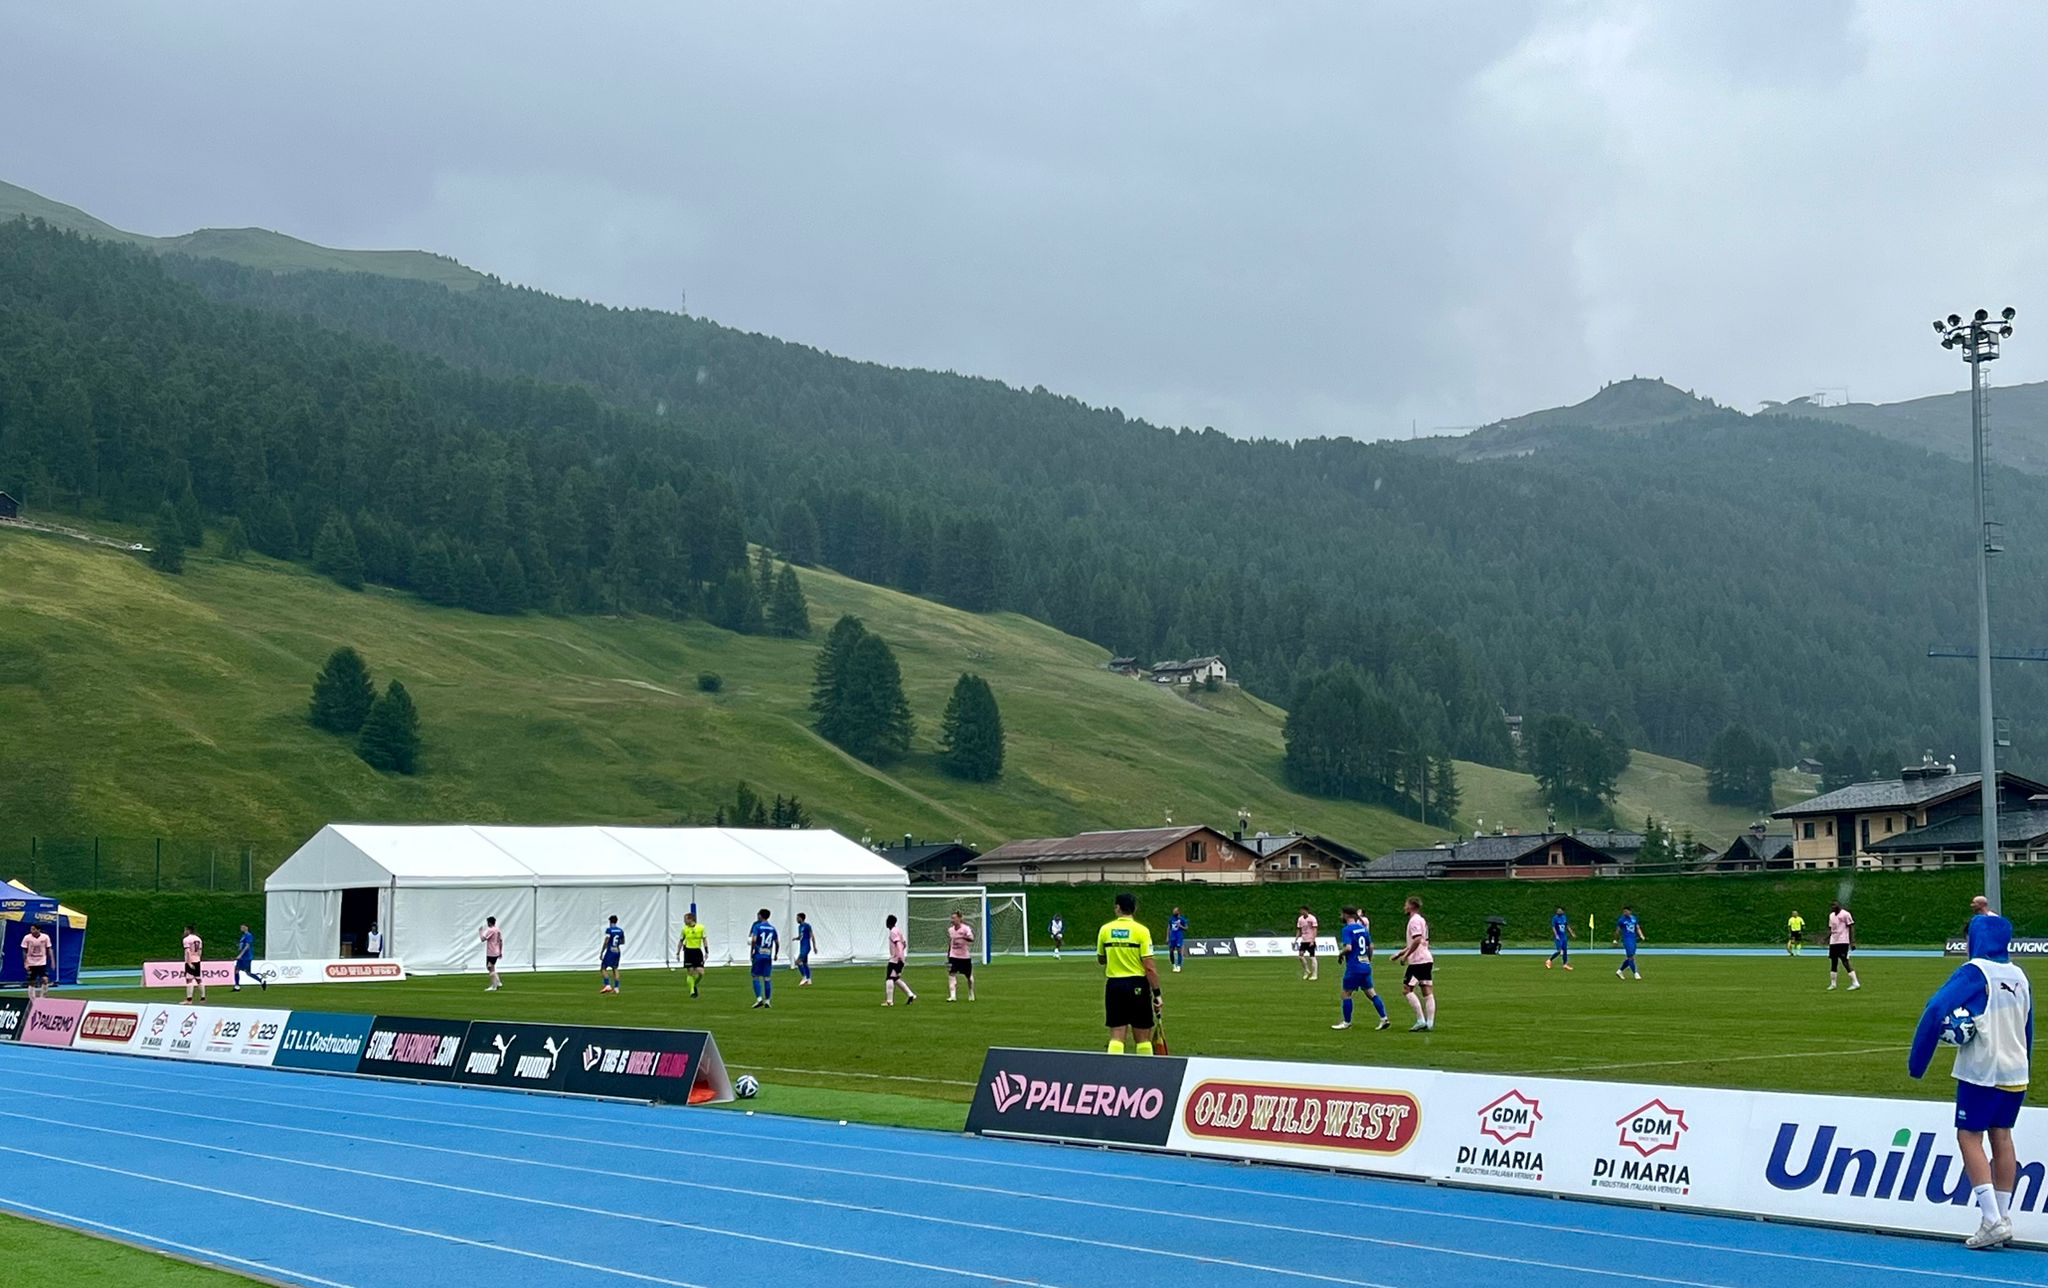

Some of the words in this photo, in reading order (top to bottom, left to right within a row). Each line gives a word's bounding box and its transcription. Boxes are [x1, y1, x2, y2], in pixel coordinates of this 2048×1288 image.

[760, 931, 774, 947] 14
[1358, 935, 1367, 955] 9
[171, 969, 230, 979] PARMO
[328, 966, 348, 976] OLD
[347, 966, 372, 976] WILD
[371, 965, 398, 975] WEST
[39, 1013, 74, 1032] PALERMO
[221, 1021, 241, 1038] 229
[257, 1023, 278, 1041] 229
[464, 1052, 501, 1075] PUMA
[513, 1055, 552, 1079] PUMA
[599, 1049, 621, 1073] THIS
[616, 1050, 630, 1073] IS
[626, 1051, 655, 1075] WHERE
[1025, 1080, 1164, 1120] PALERMO
[1194, 1091, 1248, 1128] OLD
[1250, 1095, 1321, 1135] WILD
[1324, 1099, 1411, 1141] WEST
[1492, 1107, 1528, 1124] GDM
[1632, 1117, 1672, 1135] GDM
[1457, 1146, 1477, 1165] DI
[1481, 1148, 1543, 1171] MARIA
[1593, 1158, 1616, 1178] DI
[1620, 1160, 1690, 1185] MARIA
[1599, 1180, 1629, 1189] INDUSTRIA
[1629, 1183, 1657, 1192] ITALIANA
[1657, 1186, 1681, 1195] VERNICI
